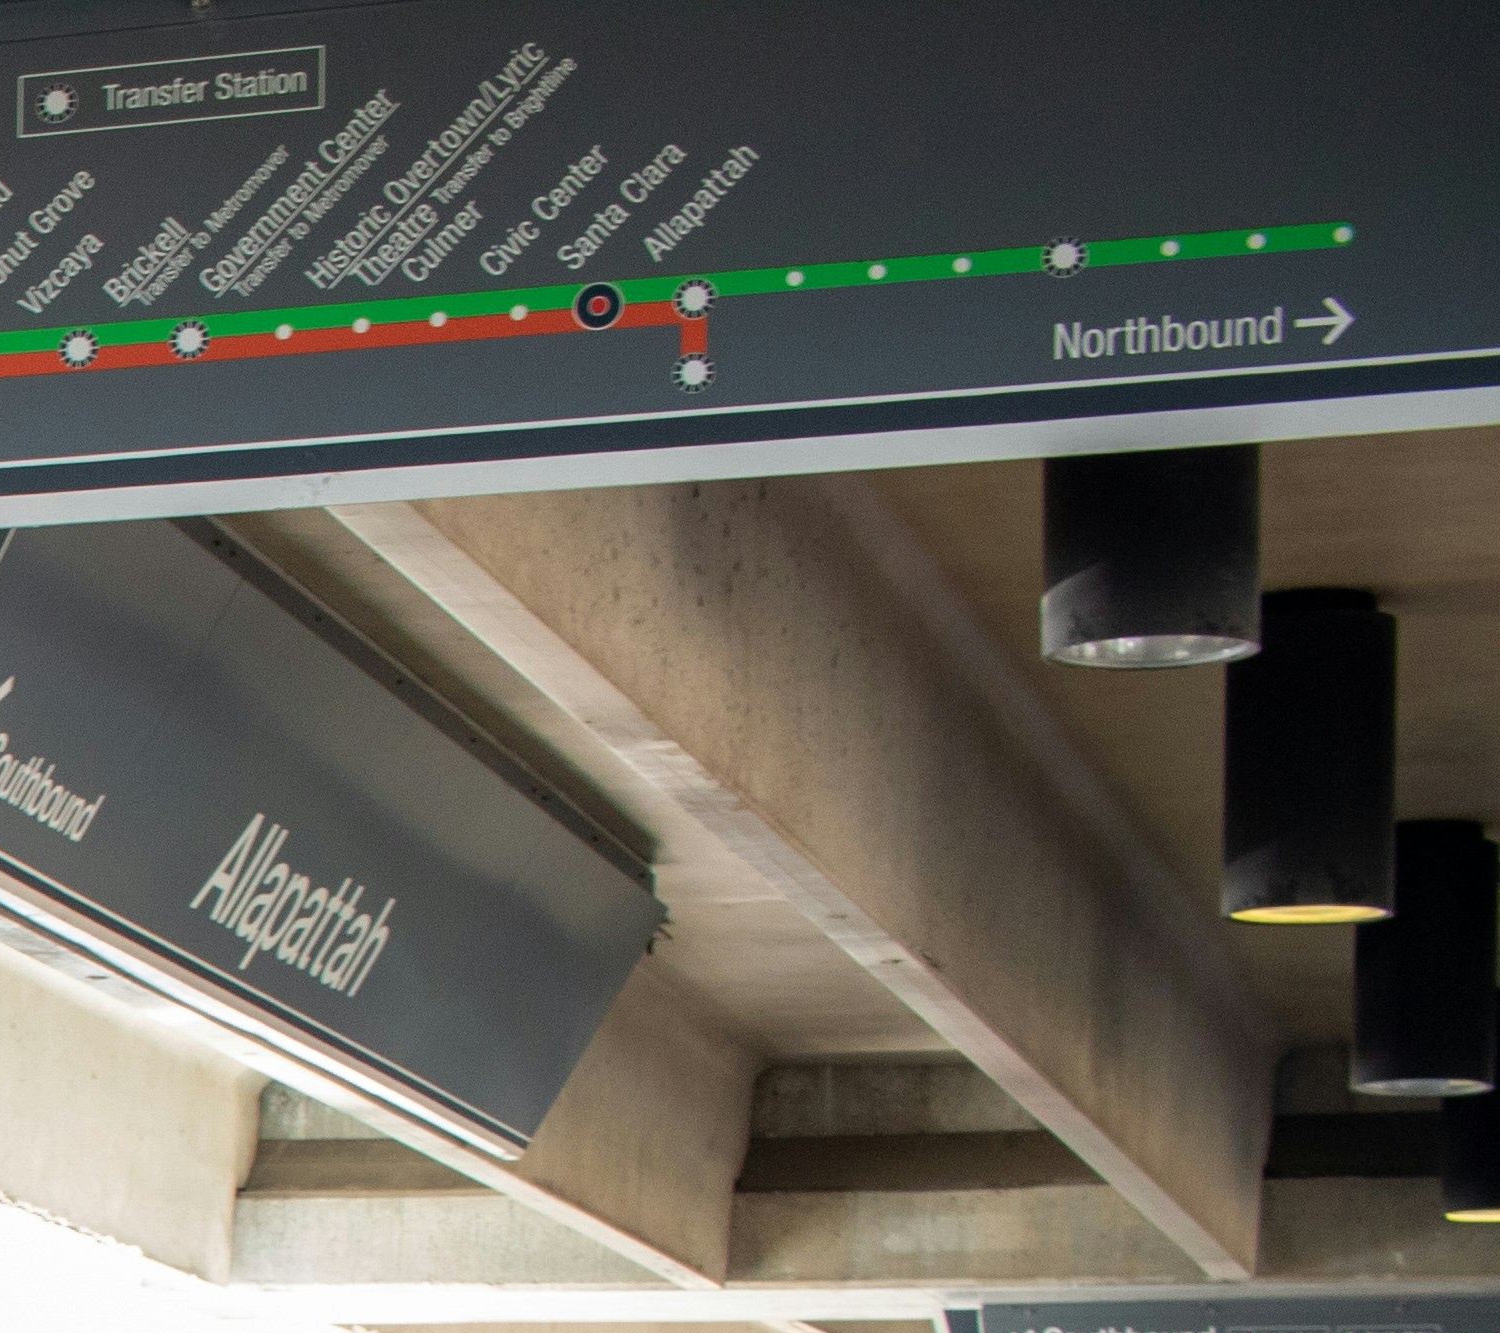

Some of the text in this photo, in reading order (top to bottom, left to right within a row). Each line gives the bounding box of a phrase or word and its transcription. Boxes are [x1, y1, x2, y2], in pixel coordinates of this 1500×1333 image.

[101, 67, 308, 112] Transfer Station
[28, 171, 95, 234] Grove
[135, 144, 290, 306] Transfer to Metromover
[199, 88, 393, 293] Government Center
[231, 134, 390, 297] Transfer to Metromover
[304, 42, 545, 289] Historic Overtown/Lyric
[347, 57, 578, 286] Theatre Transfer to Brightline
[480, 144, 609, 276] Civic Center
[556, 143, 688, 270] Santa Clara
[643, 145, 760, 263] Allapattah
[17, 234, 104, 314] Vizcaya
[102, 217, 189, 303] Brickell
[402, 200, 483, 282] Culmer
[1053, 306, 1283, 360] Northbound
[190, 812, 396, 997] Allapattah
